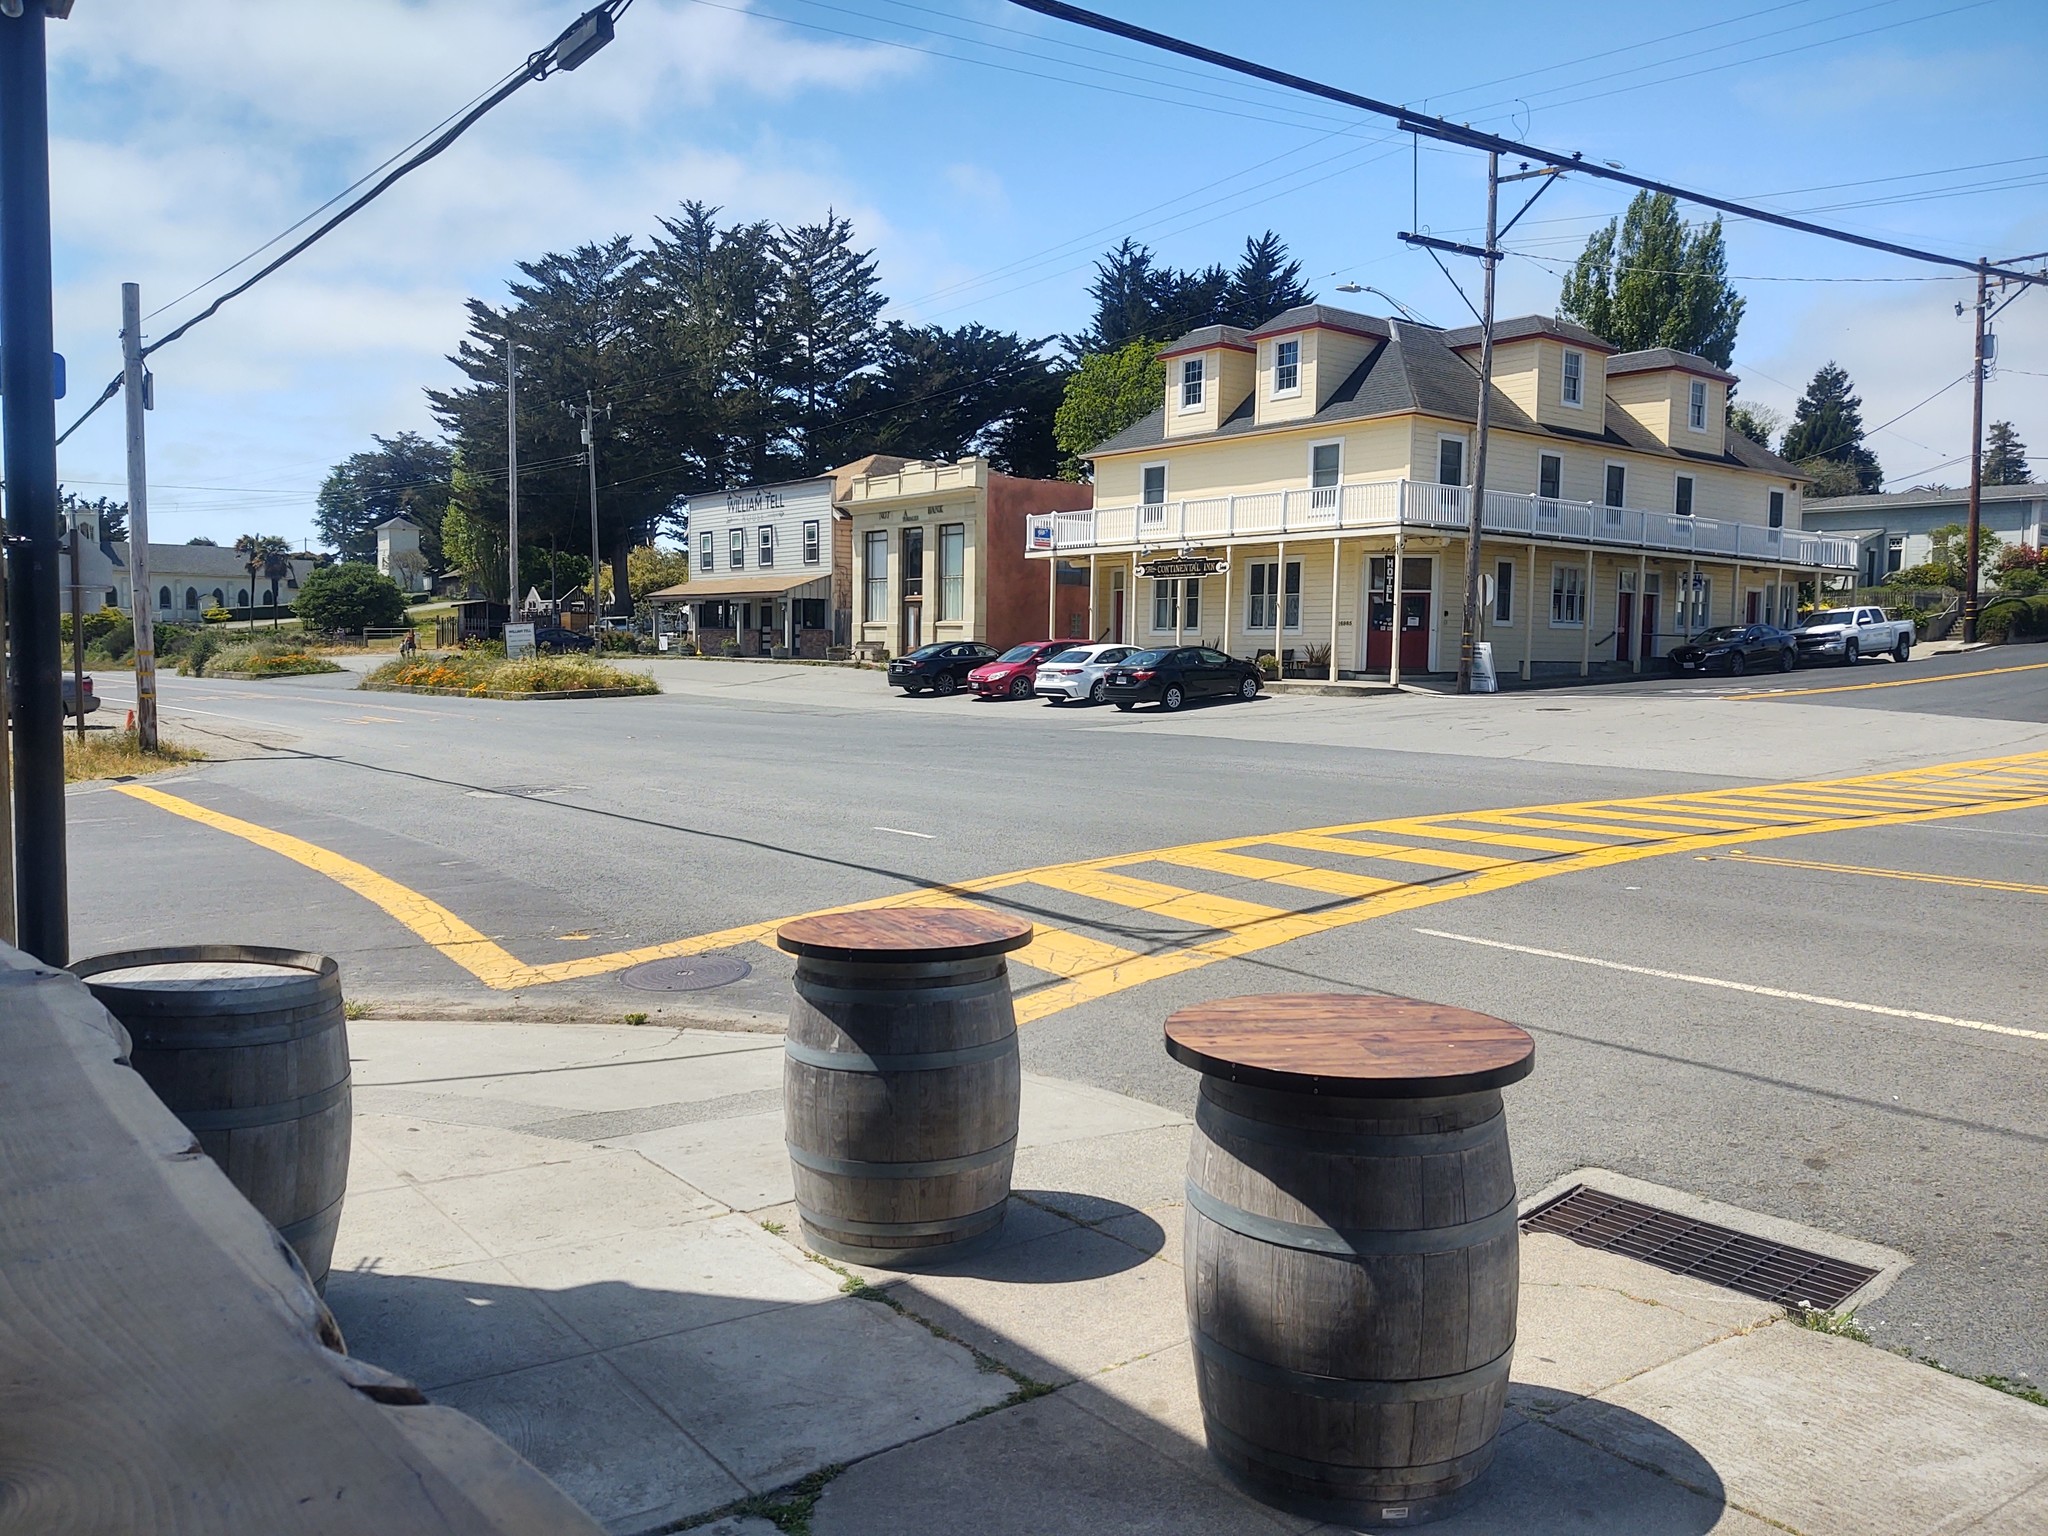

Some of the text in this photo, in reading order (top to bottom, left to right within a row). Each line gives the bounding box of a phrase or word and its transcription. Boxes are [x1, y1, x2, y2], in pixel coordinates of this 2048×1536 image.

[727, 494, 785, 513] WILLIAM TELL
[1157, 563, 1200, 573] CONTINENTAL
[1203, 562, 1215, 571] INN
